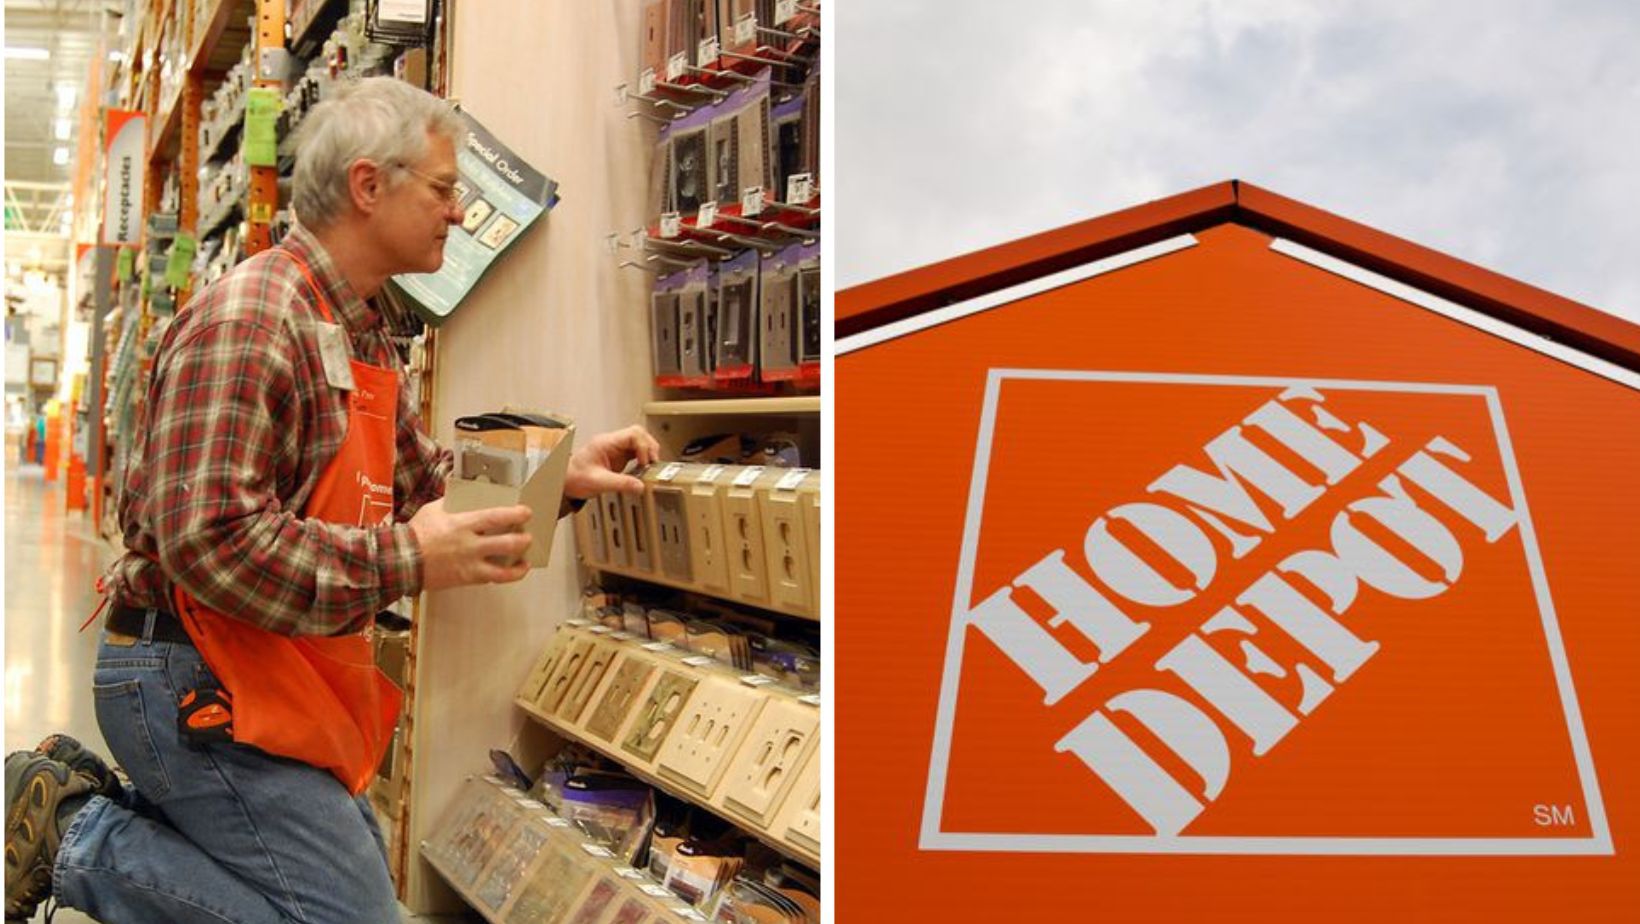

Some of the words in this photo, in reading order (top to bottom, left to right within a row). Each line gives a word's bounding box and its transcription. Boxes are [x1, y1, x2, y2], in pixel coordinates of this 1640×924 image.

[118, 156, 132, 241] Receptacles
[467, 132, 499, 162] Special
[496, 160, 524, 184] Order
[967, 385, 1390, 706] HOME
[1054, 435, 1520, 837] DEPOT
[1532, 804, 1576, 826] SM
